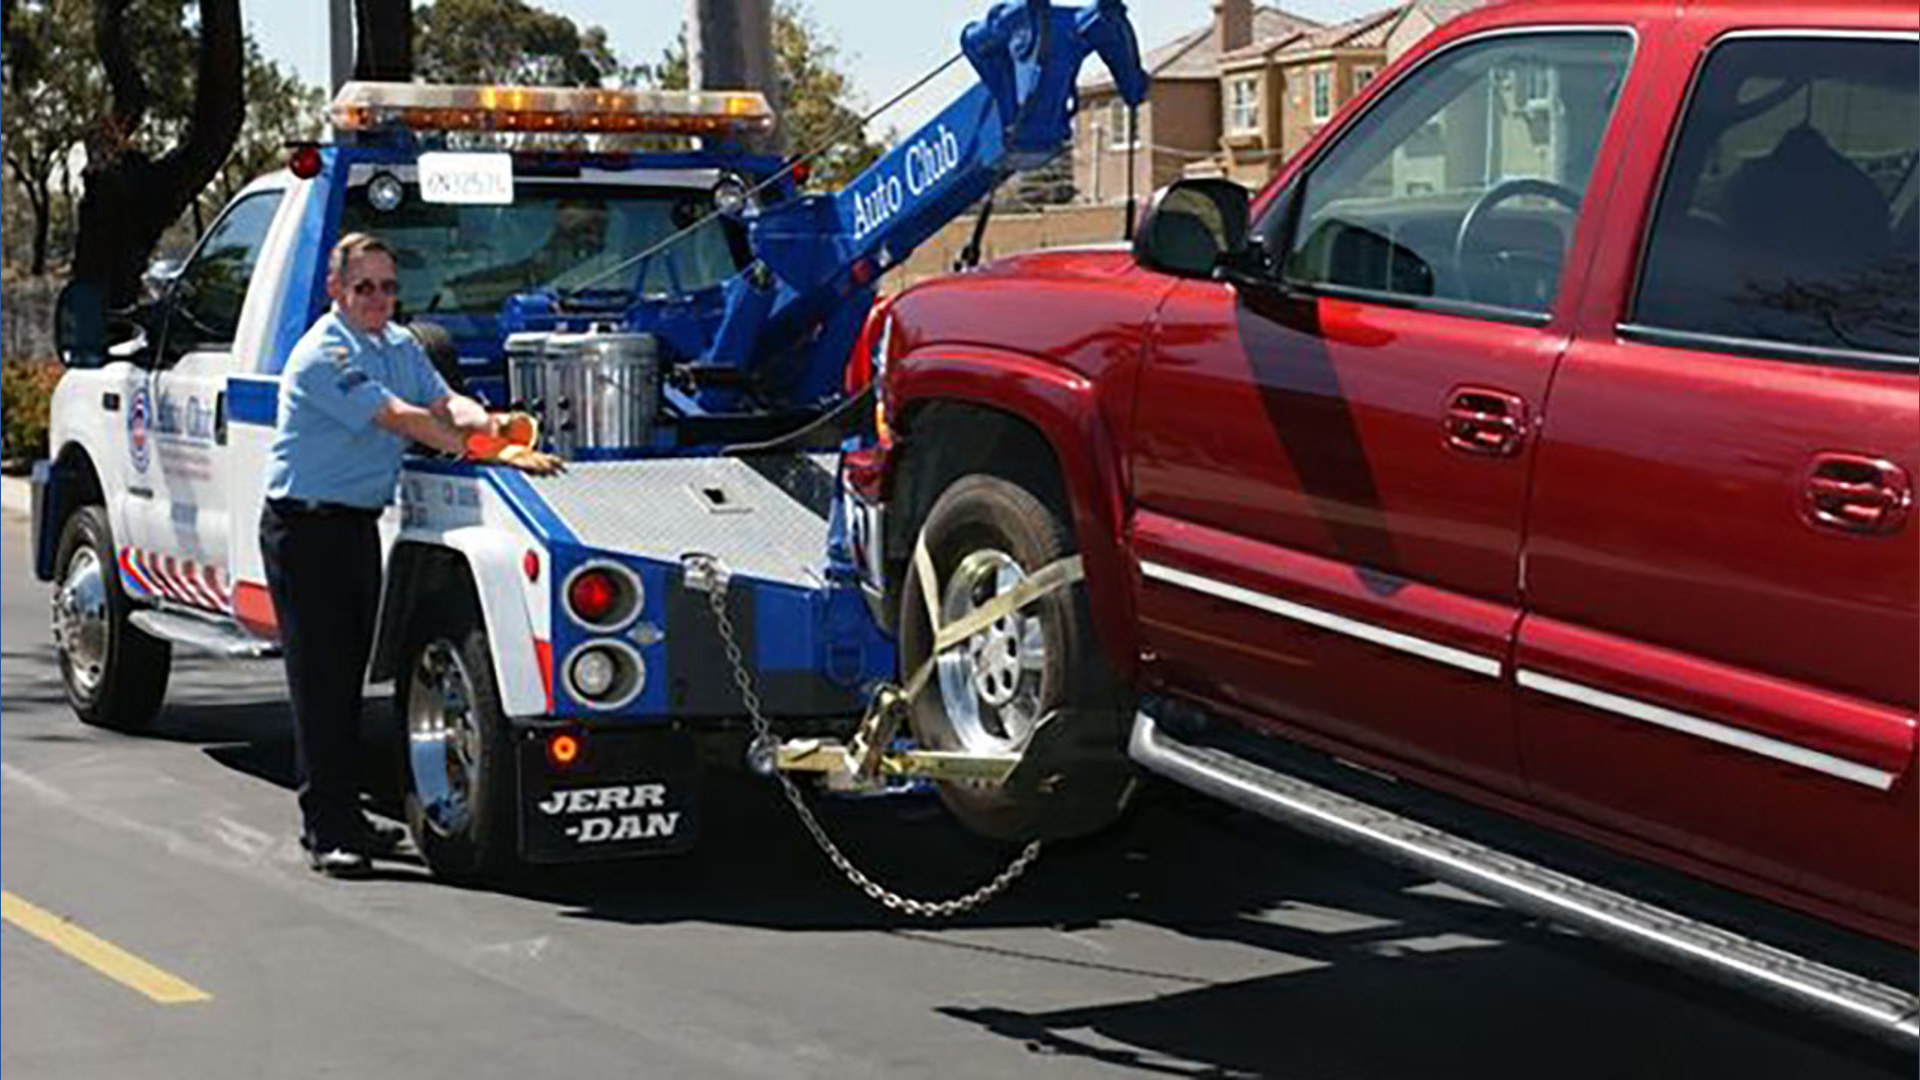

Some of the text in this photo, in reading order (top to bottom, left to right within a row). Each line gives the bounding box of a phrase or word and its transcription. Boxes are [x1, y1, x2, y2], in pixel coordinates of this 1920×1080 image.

[853, 123, 959, 240] Auto Club
[538, 783, 666, 815] JERR
[565, 811, 681, 843] -DAN
